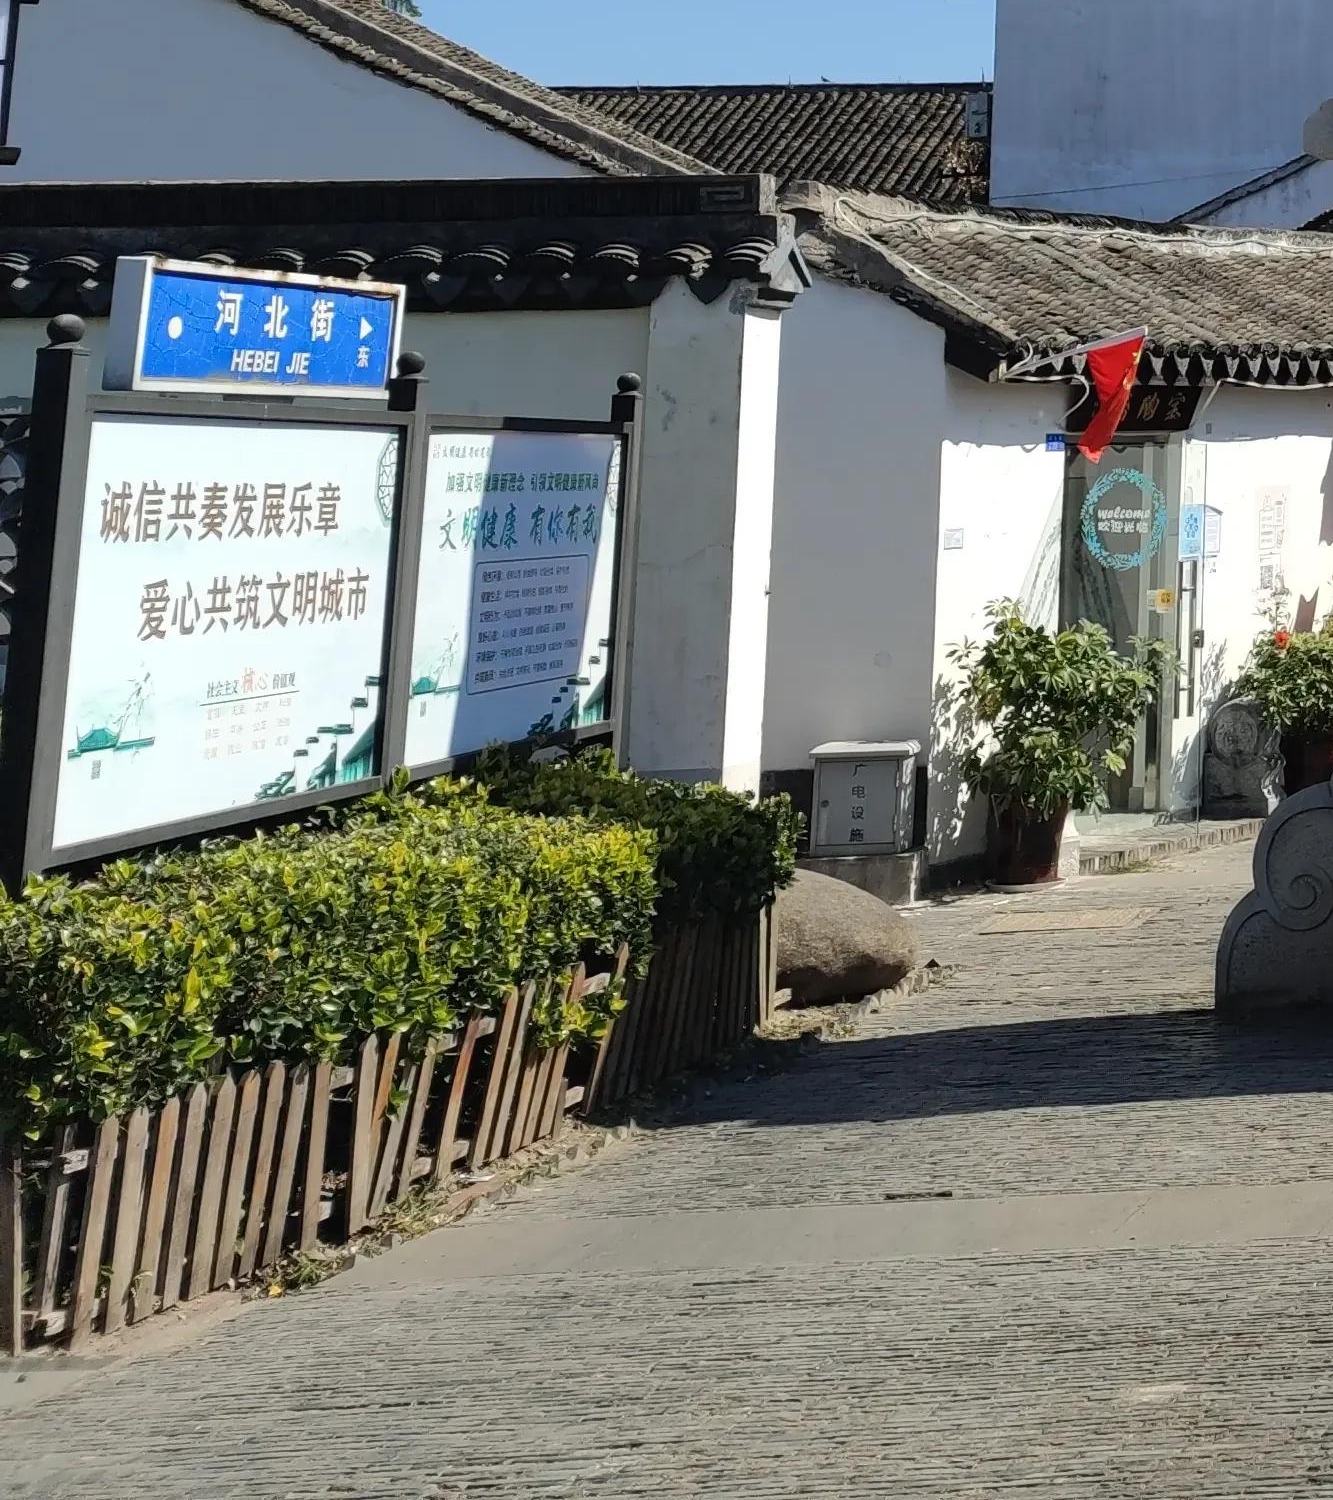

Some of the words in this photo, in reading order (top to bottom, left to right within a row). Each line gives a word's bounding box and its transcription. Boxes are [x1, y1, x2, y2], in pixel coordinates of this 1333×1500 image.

[215, 290, 336, 341] 河北街
[231, 349, 280, 373] HEBEI
[286, 351, 311, 374] JIE
[357, 346, 369, 368] 东
[446, 472, 525, 493] 加强文明健康新理念
[530, 472, 599, 493] 引领文明健康新风尚
[99, 480, 341, 543] 诚信共奏发展乐章
[439, 502, 519, 550] 文明健康
[529, 503, 598, 546] 有你有我
[1097, 520, 1149, 533] 欢迎光临
[137, 567, 370, 641] 爱心共筑文明城市
[849, 763, 867, 842] 广电设施
